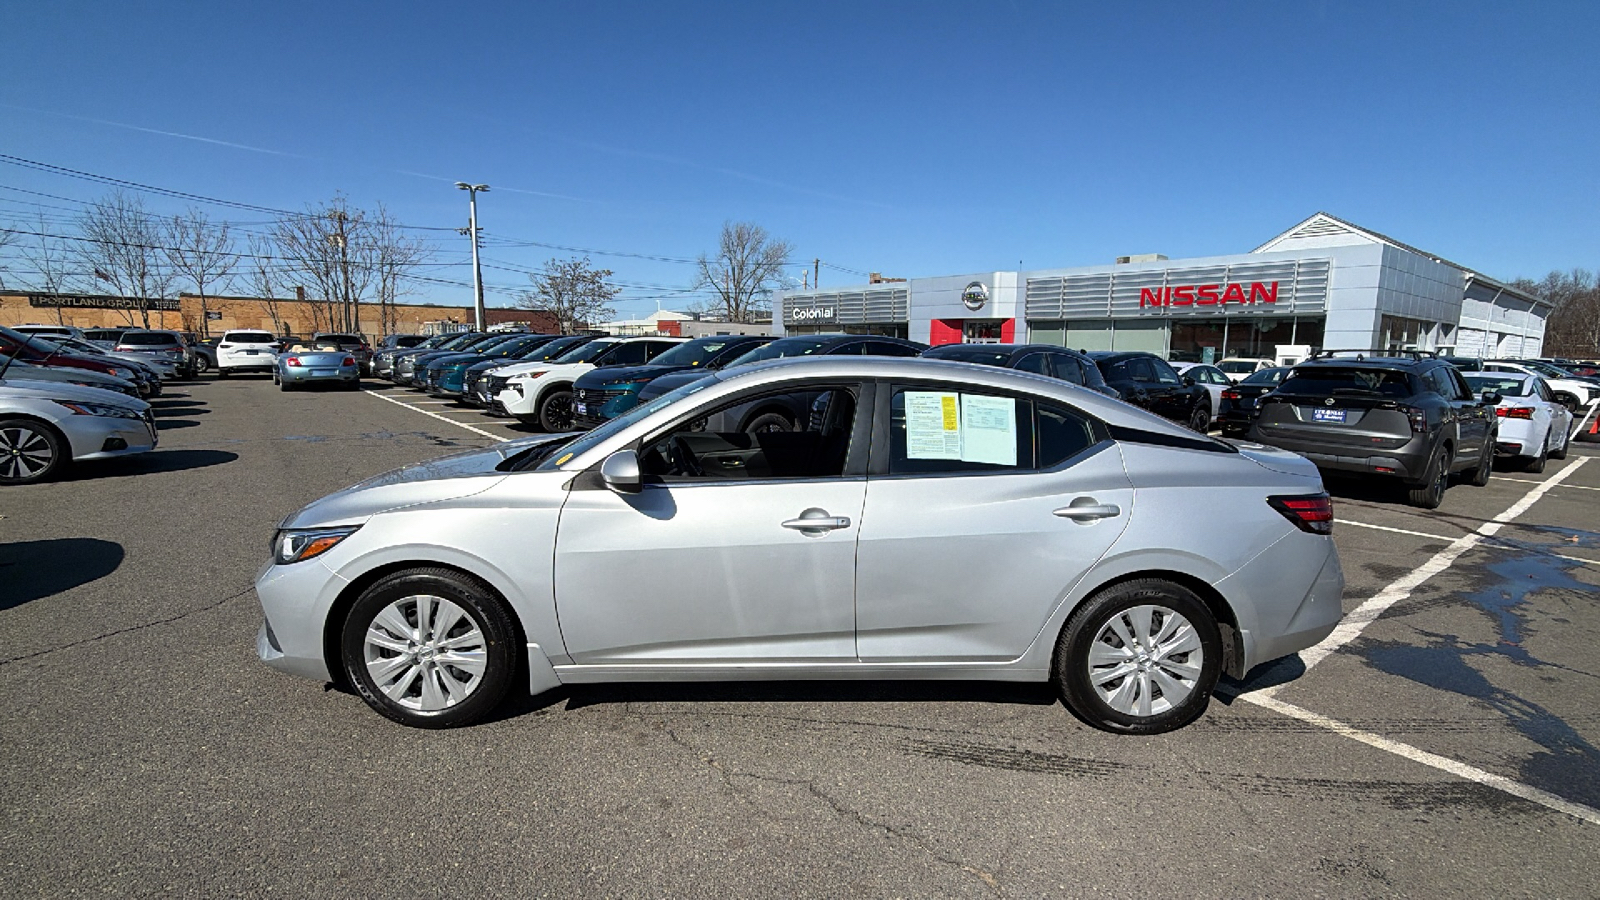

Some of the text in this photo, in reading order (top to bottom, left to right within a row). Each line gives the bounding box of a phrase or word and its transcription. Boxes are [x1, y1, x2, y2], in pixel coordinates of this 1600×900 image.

[1139, 281, 1279, 307] NISSAN
[38, 296, 105, 306] PORTLAND
[106, 299, 149, 308] GROUP
[793, 306, 833, 319] Colonial
